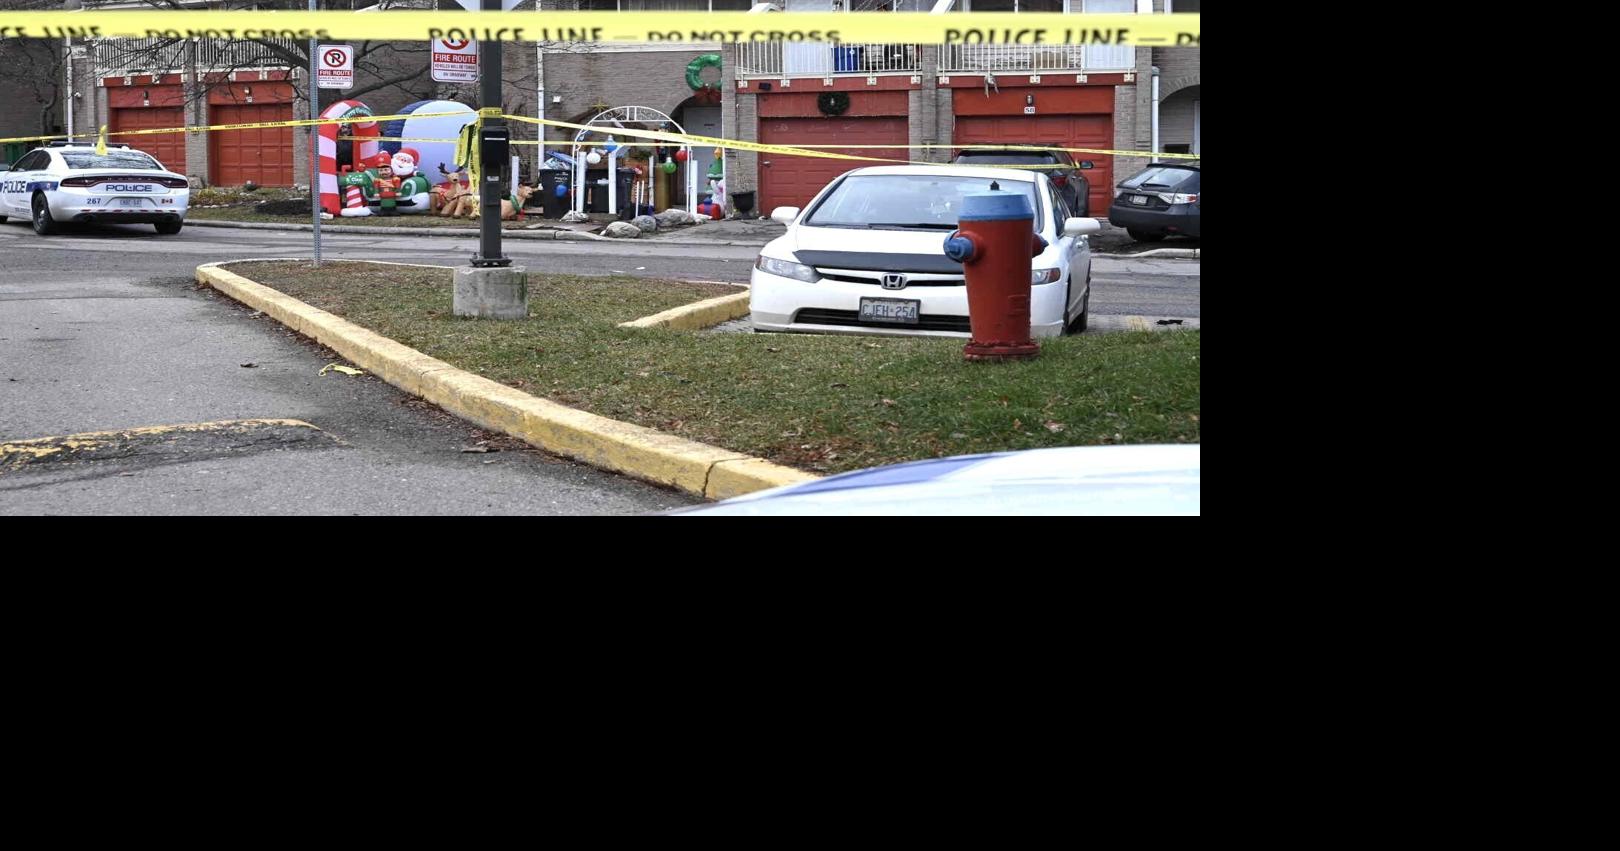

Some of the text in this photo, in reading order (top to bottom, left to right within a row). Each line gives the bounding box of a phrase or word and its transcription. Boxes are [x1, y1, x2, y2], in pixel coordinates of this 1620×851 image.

[434, 53, 476, 64] FIRE ROUTE
[106, 184, 152, 192] POLICE
